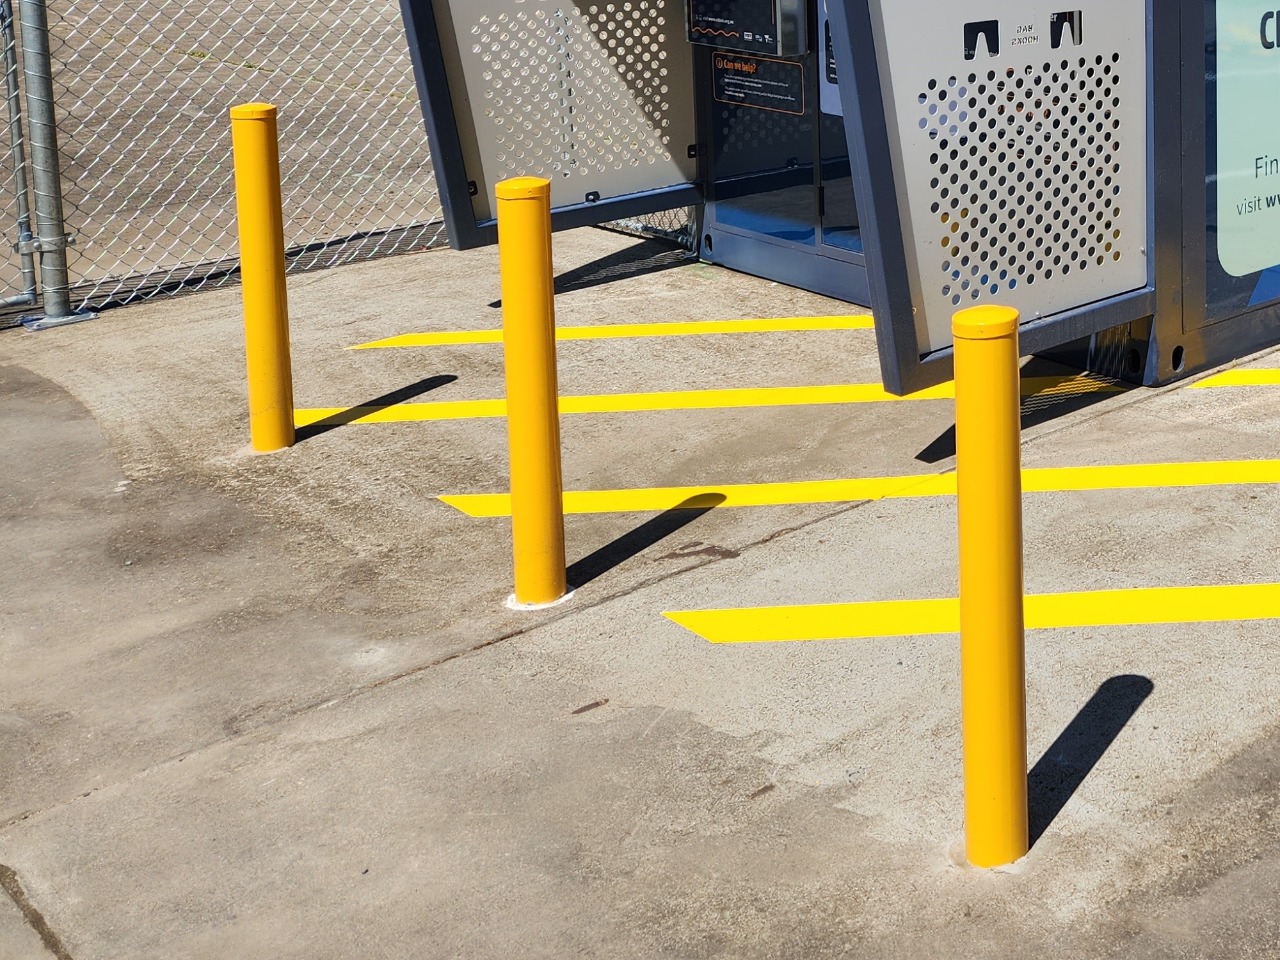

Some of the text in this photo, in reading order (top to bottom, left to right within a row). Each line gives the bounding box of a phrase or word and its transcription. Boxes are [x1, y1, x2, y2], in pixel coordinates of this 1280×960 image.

[723, 59, 756, 74] Can we help?
[1236, 196, 1262, 216] visit
